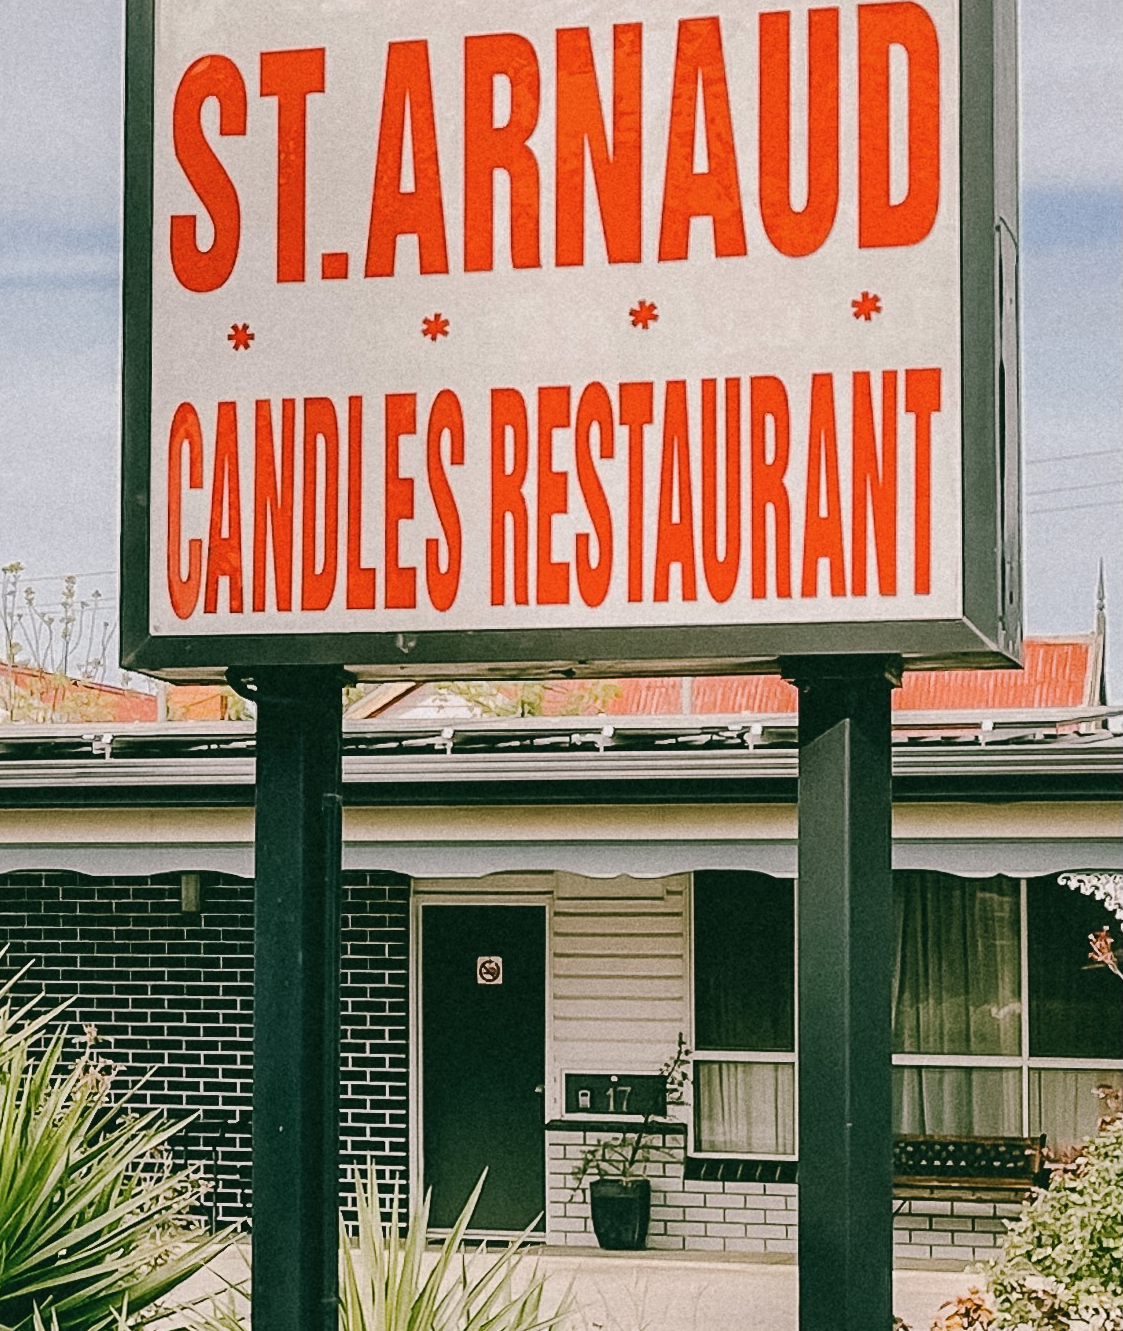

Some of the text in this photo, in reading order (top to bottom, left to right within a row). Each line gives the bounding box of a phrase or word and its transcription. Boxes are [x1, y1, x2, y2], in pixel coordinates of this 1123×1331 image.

[166, 367, 942, 621] CANDLES RESTAURANT
[606, 1086, 632, 1112] 17
